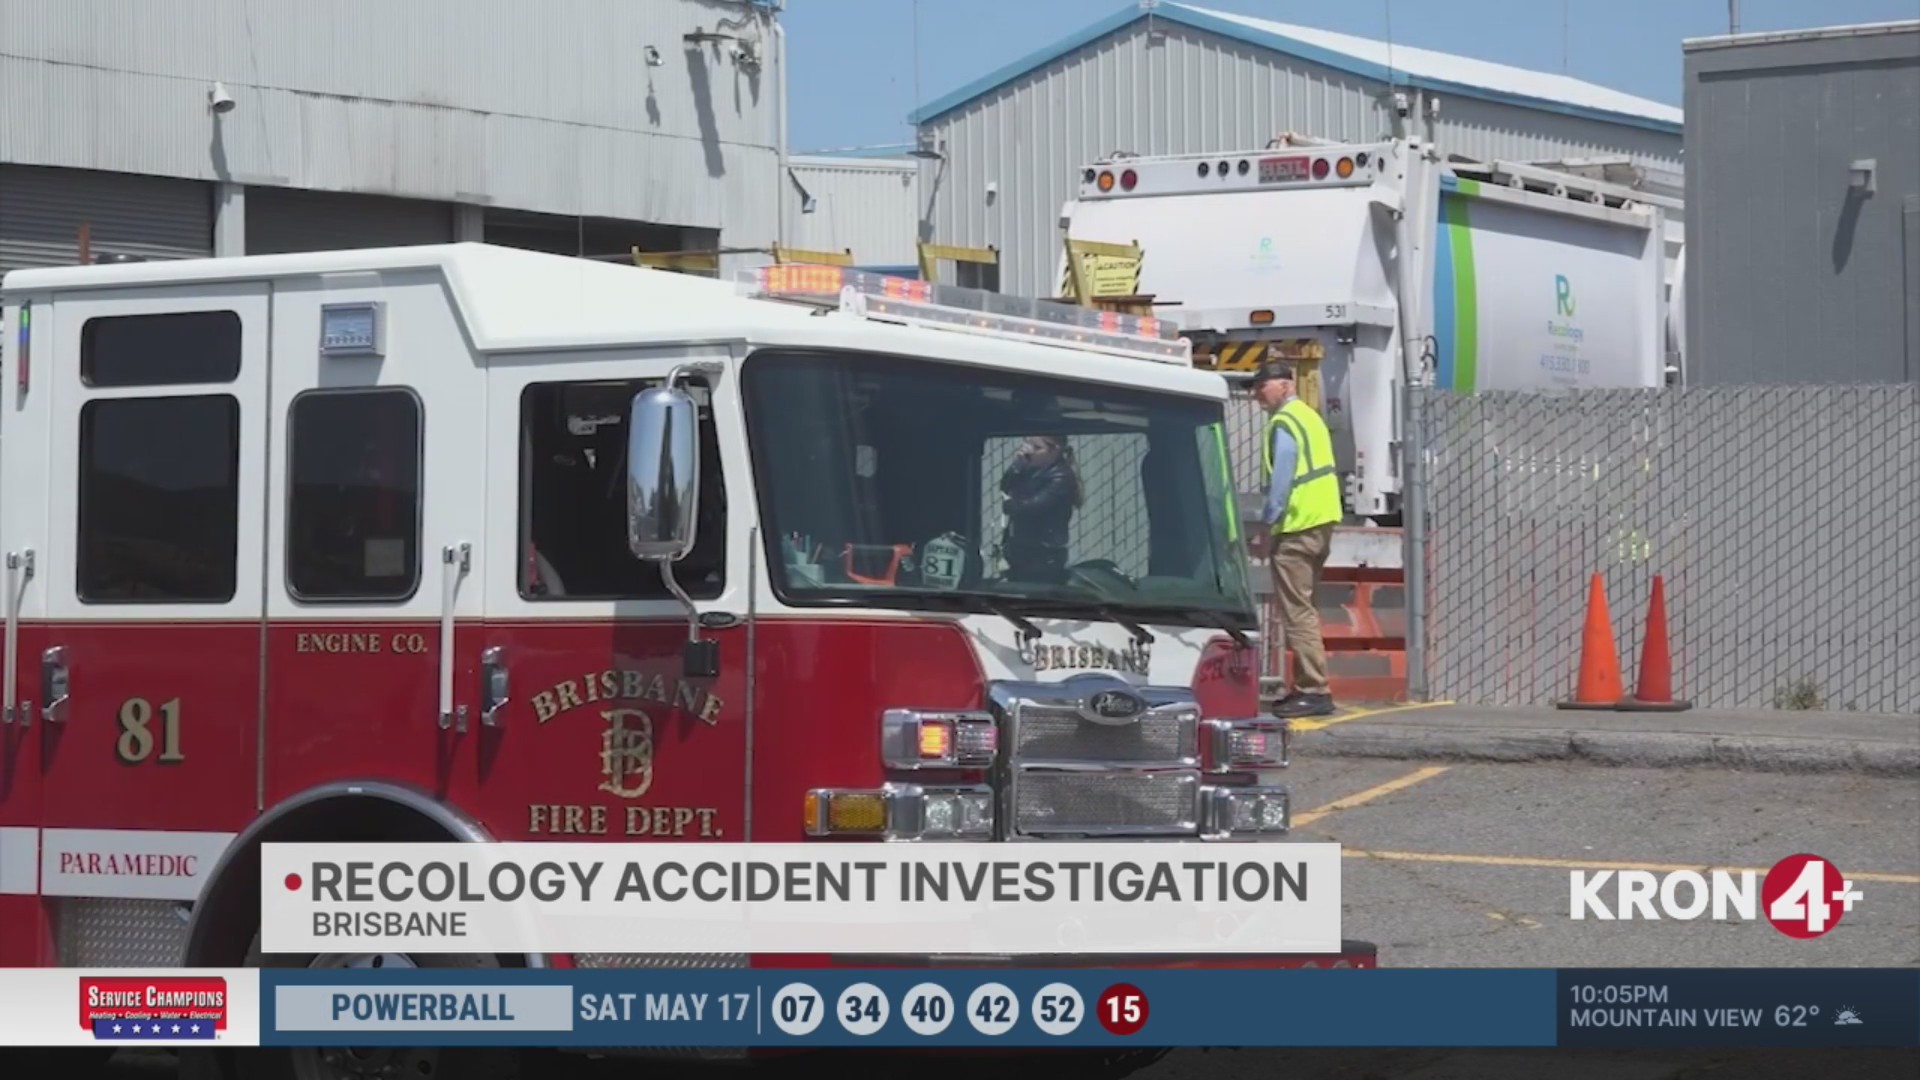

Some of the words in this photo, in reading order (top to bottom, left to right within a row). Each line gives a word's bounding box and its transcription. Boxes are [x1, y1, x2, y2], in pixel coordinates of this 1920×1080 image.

[1325, 304, 1346, 319] 531
[924, 556, 957, 577] 81
[296, 633, 380, 653] ENGINE
[391, 633, 428, 653] CO.
[530, 669, 725, 727] BRISBANE
[116, 698, 185, 764] 81
[529, 804, 608, 835] FIRE
[625, 806, 724, 837] DEPT.
[59, 851, 198, 878] PARAMEDIC
